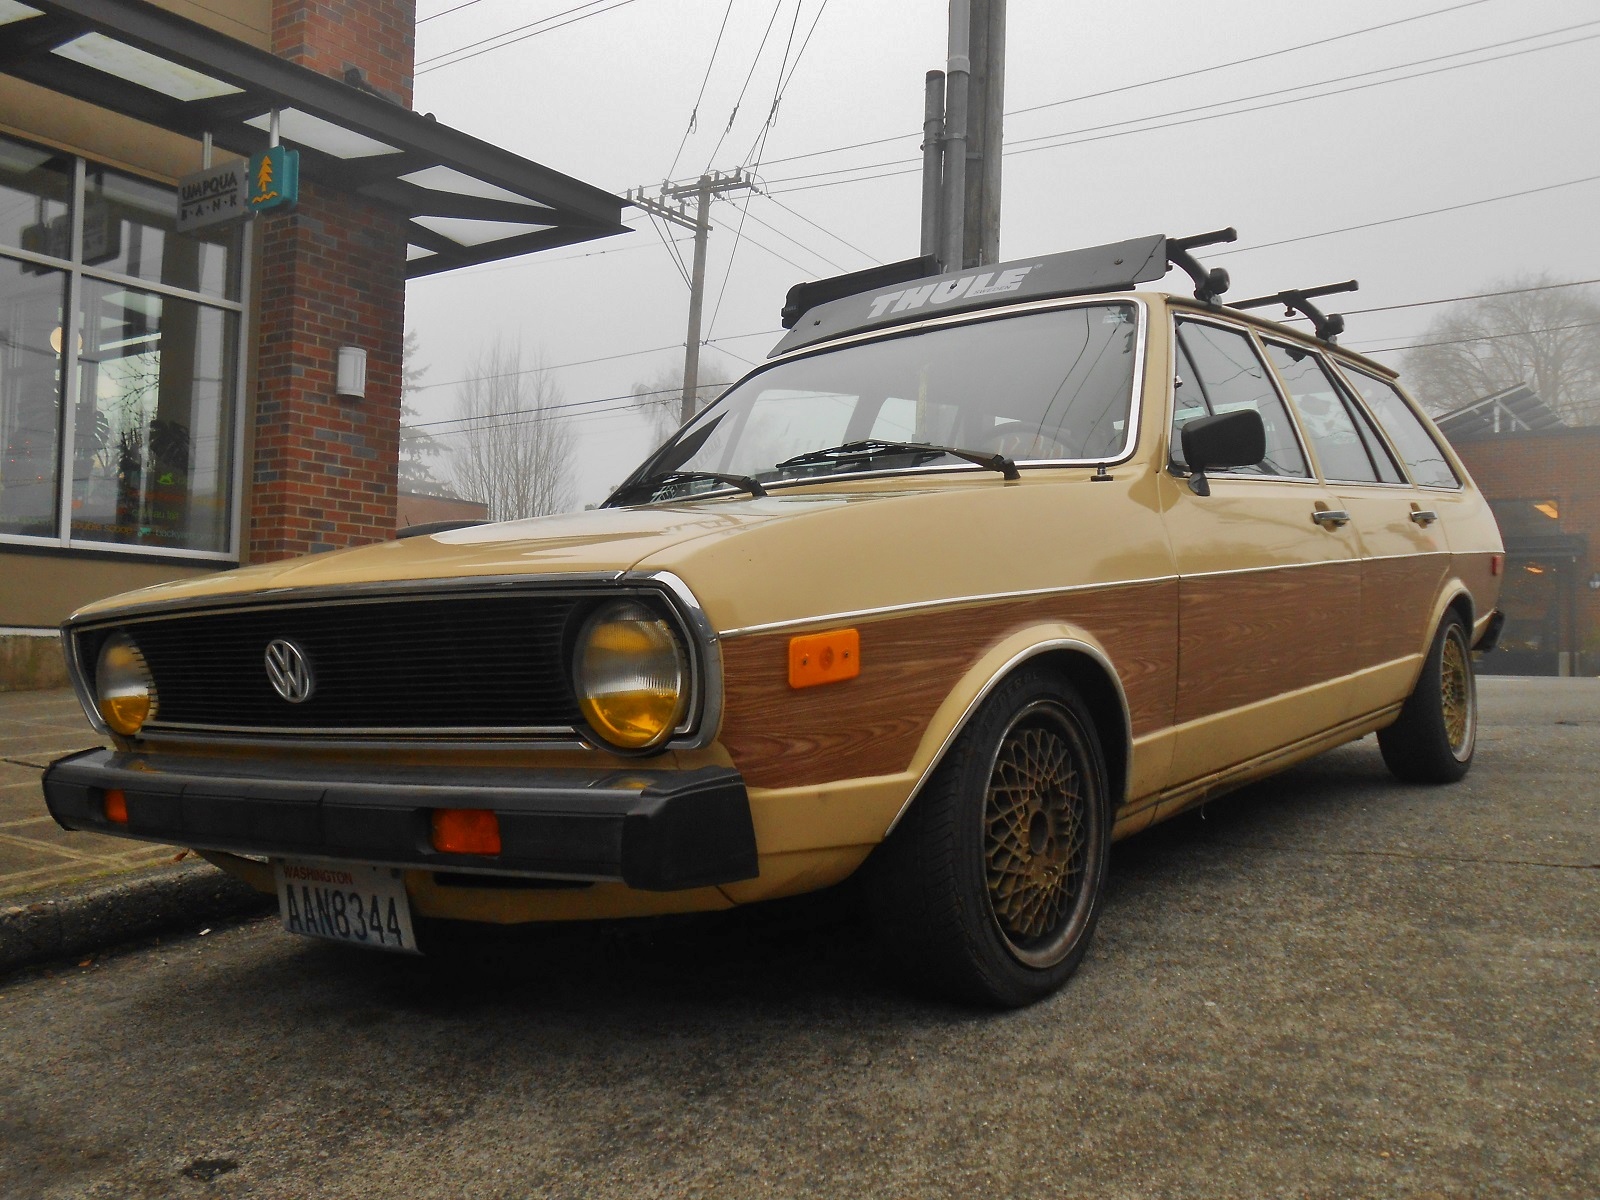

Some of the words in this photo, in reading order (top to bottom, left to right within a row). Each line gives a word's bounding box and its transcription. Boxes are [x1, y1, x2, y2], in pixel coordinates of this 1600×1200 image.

[182, 172, 237, 200] UMPQUA
[867, 266, 1033, 319] THULE
[974, 284, 1012, 295] SWEDEN
[283, 865, 353, 885] WASHINGTON
[286, 884, 403, 946] AAN8344
